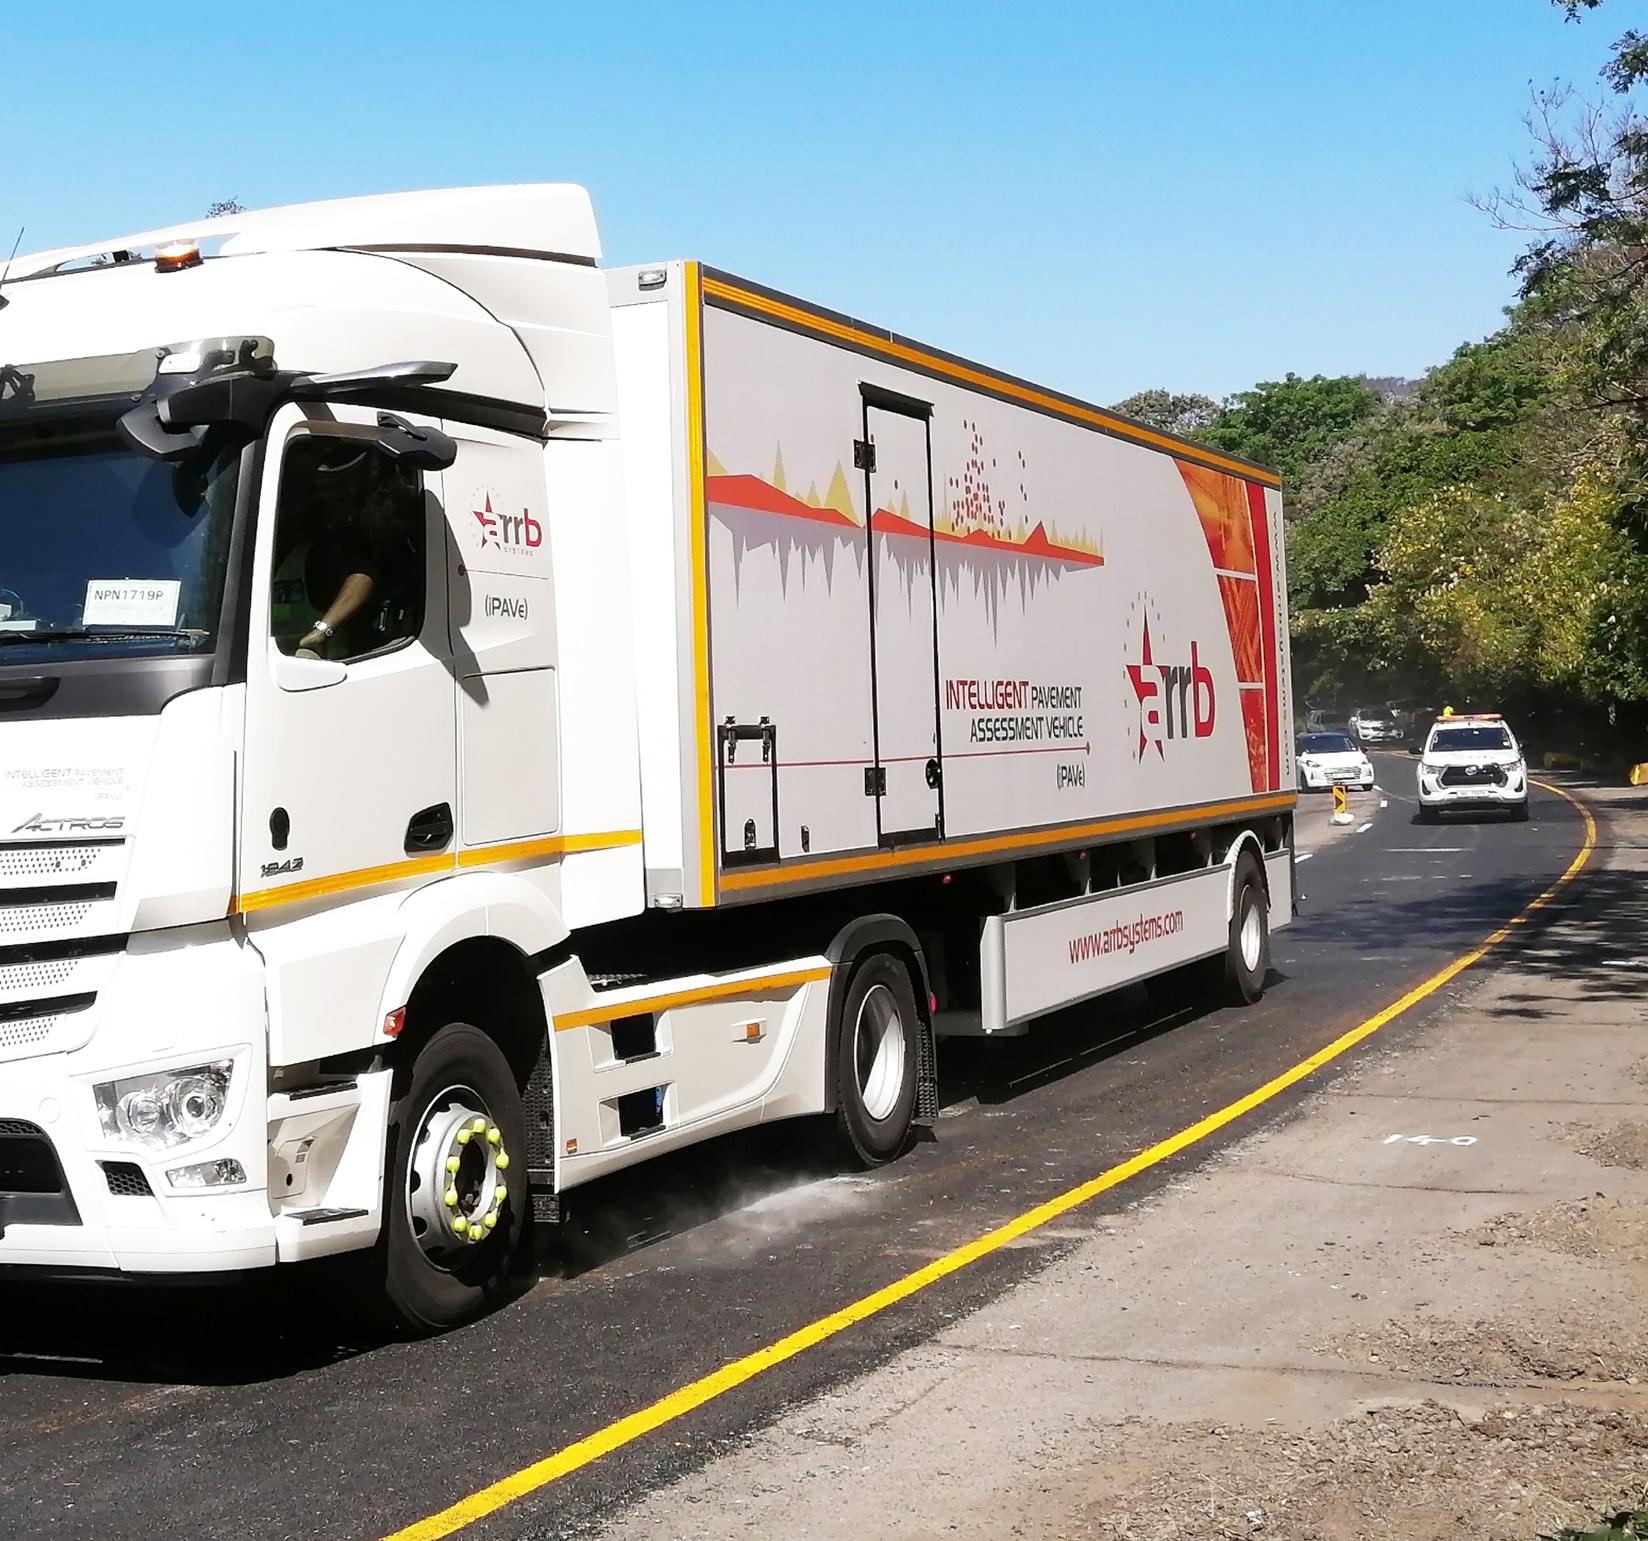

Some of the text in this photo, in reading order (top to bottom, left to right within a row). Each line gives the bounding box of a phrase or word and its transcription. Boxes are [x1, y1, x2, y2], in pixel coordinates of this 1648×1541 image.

[483, 508, 542, 548] arrb
[94, 590, 164, 601] NPN1719P
[945, 680, 1082, 710] INTELLIGENT PAVEMENT
[1140, 640, 1216, 740] arrb
[970, 715, 1083, 742] ASSESSMENT VEHICLE
[5, 768, 124, 779] INTELLIGENT PAVEMENT
[22, 777, 123, 788] ASSESSMENT VEHICLE
[1069, 910, 1183, 964] www.arrbsystems.com
